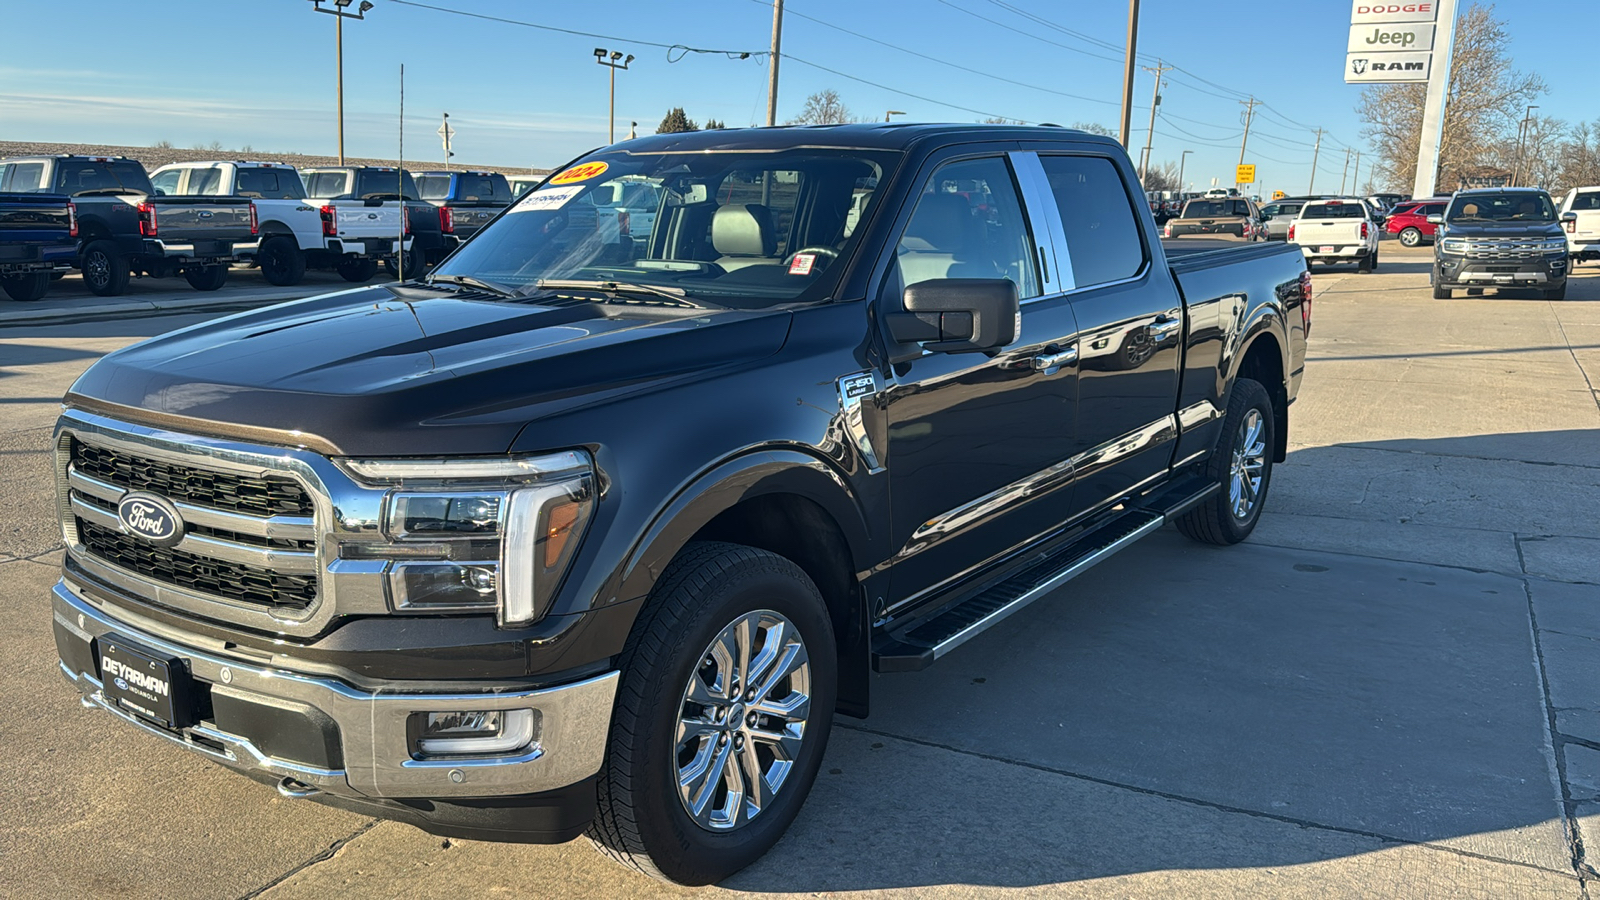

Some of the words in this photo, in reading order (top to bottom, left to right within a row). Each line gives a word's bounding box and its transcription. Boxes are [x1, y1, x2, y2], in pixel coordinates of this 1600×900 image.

[1357, 3, 1431, 14] DODGE
[1365, 28, 1415, 47] Jeep
[1371, 62, 1424, 71] RAM
[553, 165, 605, 181] 2024
[845, 377, 873, 390] F-150
[128, 502, 164, 535] Ford
[102, 655, 169, 697] DEYARMAN
[128, 685, 159, 703] INDIANOLA
